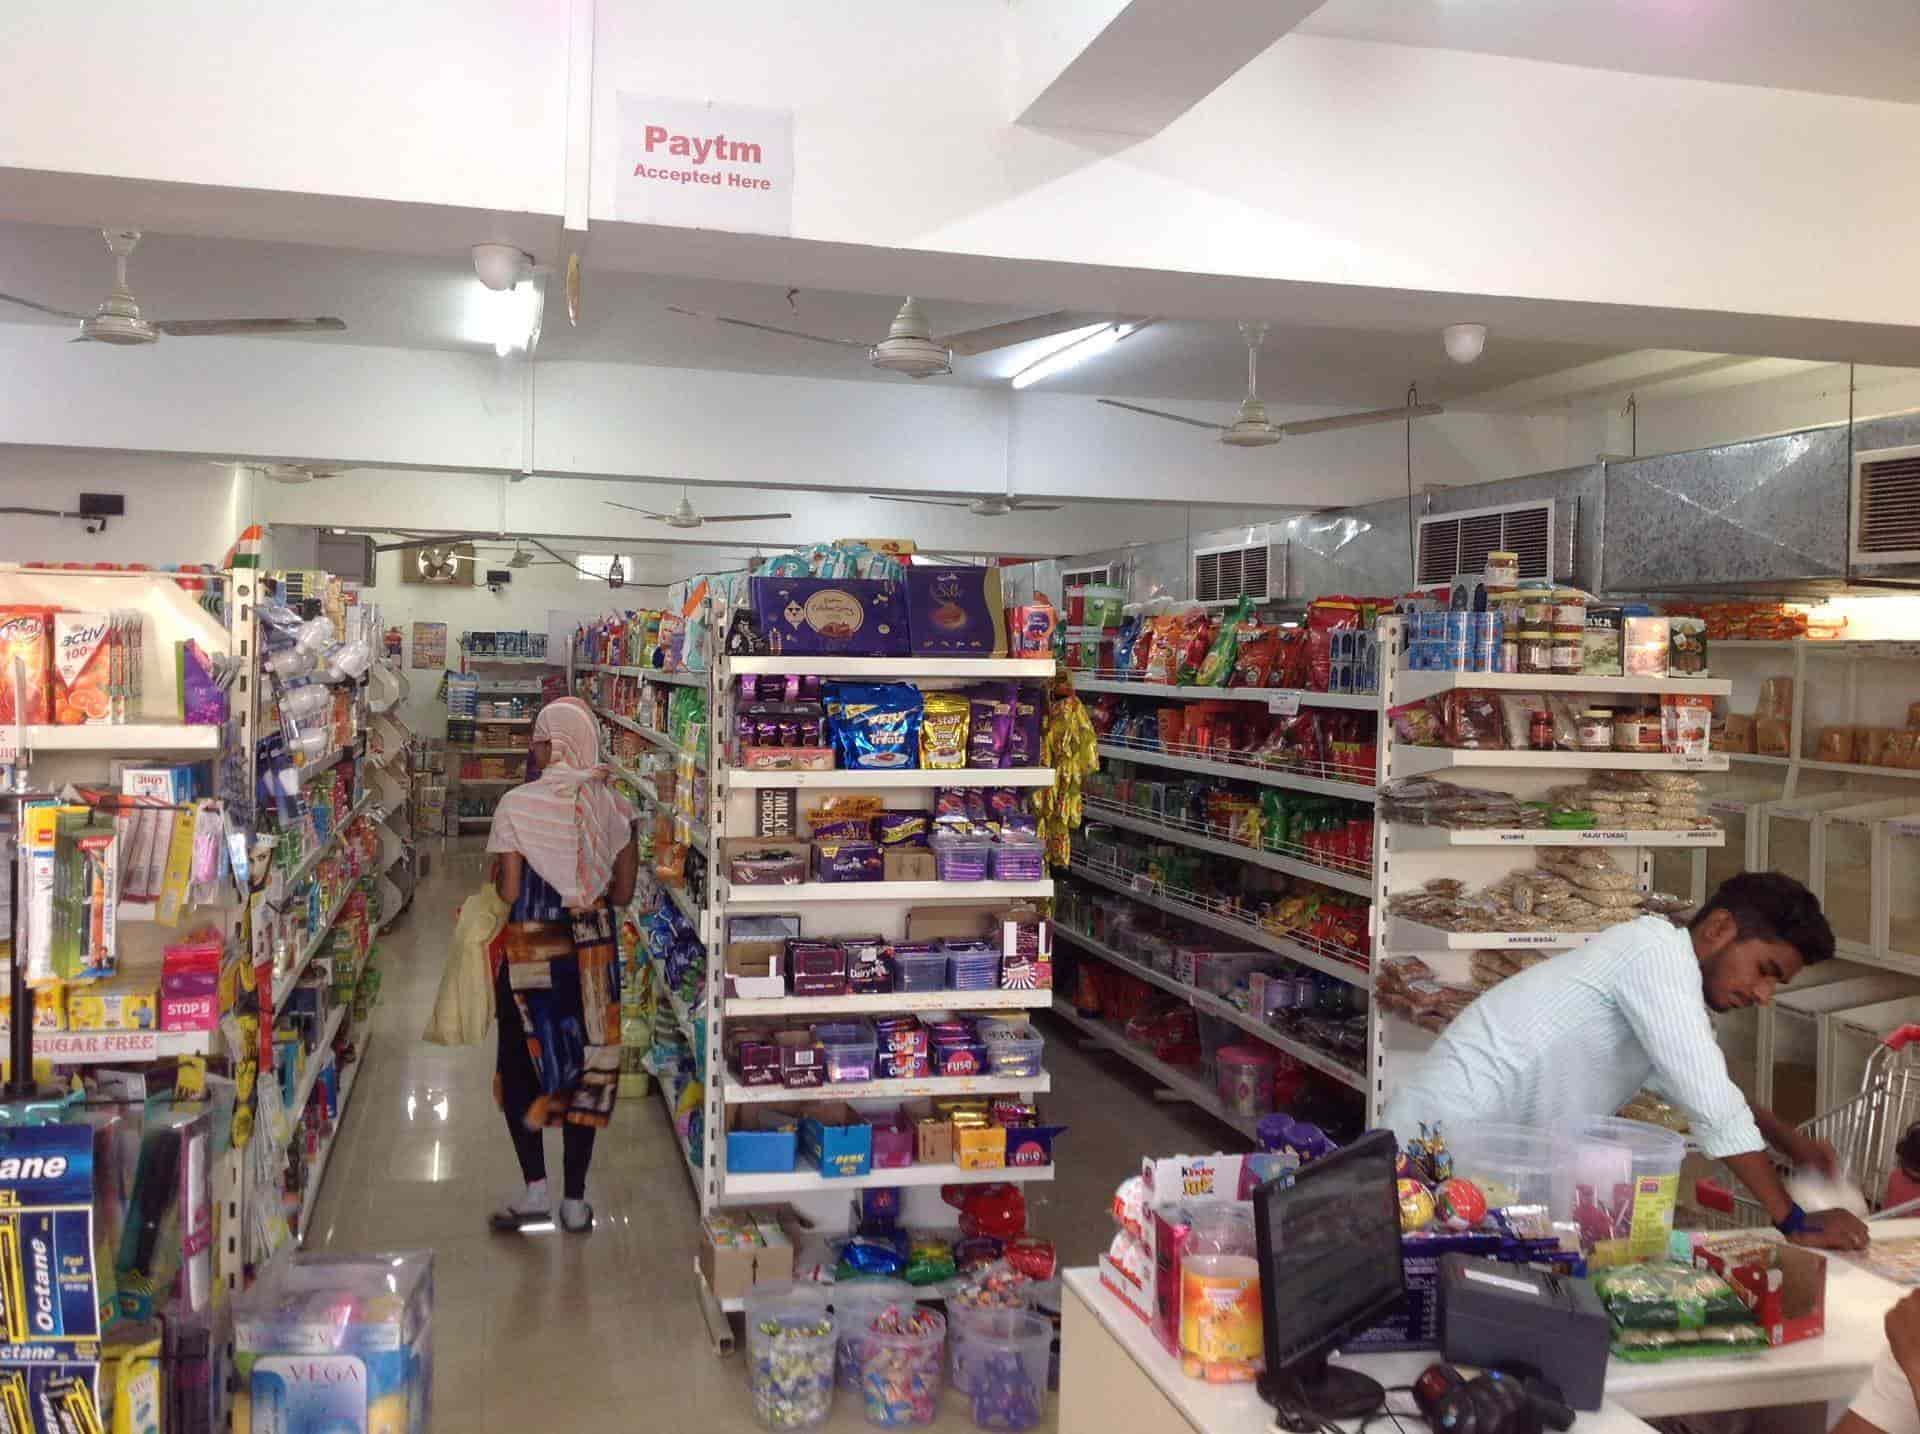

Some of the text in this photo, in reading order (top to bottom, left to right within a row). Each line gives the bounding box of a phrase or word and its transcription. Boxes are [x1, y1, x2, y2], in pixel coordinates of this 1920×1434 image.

[644, 125, 762, 165] Paytm
[633, 163, 771, 190] Accepted Here
[168, 1002, 199, 1016] STOP
[32, 1035, 154, 1054] SUGAR FREE
[32, 1237, 55, 1332] Octane
[287, 1363, 360, 1383] VEGA
